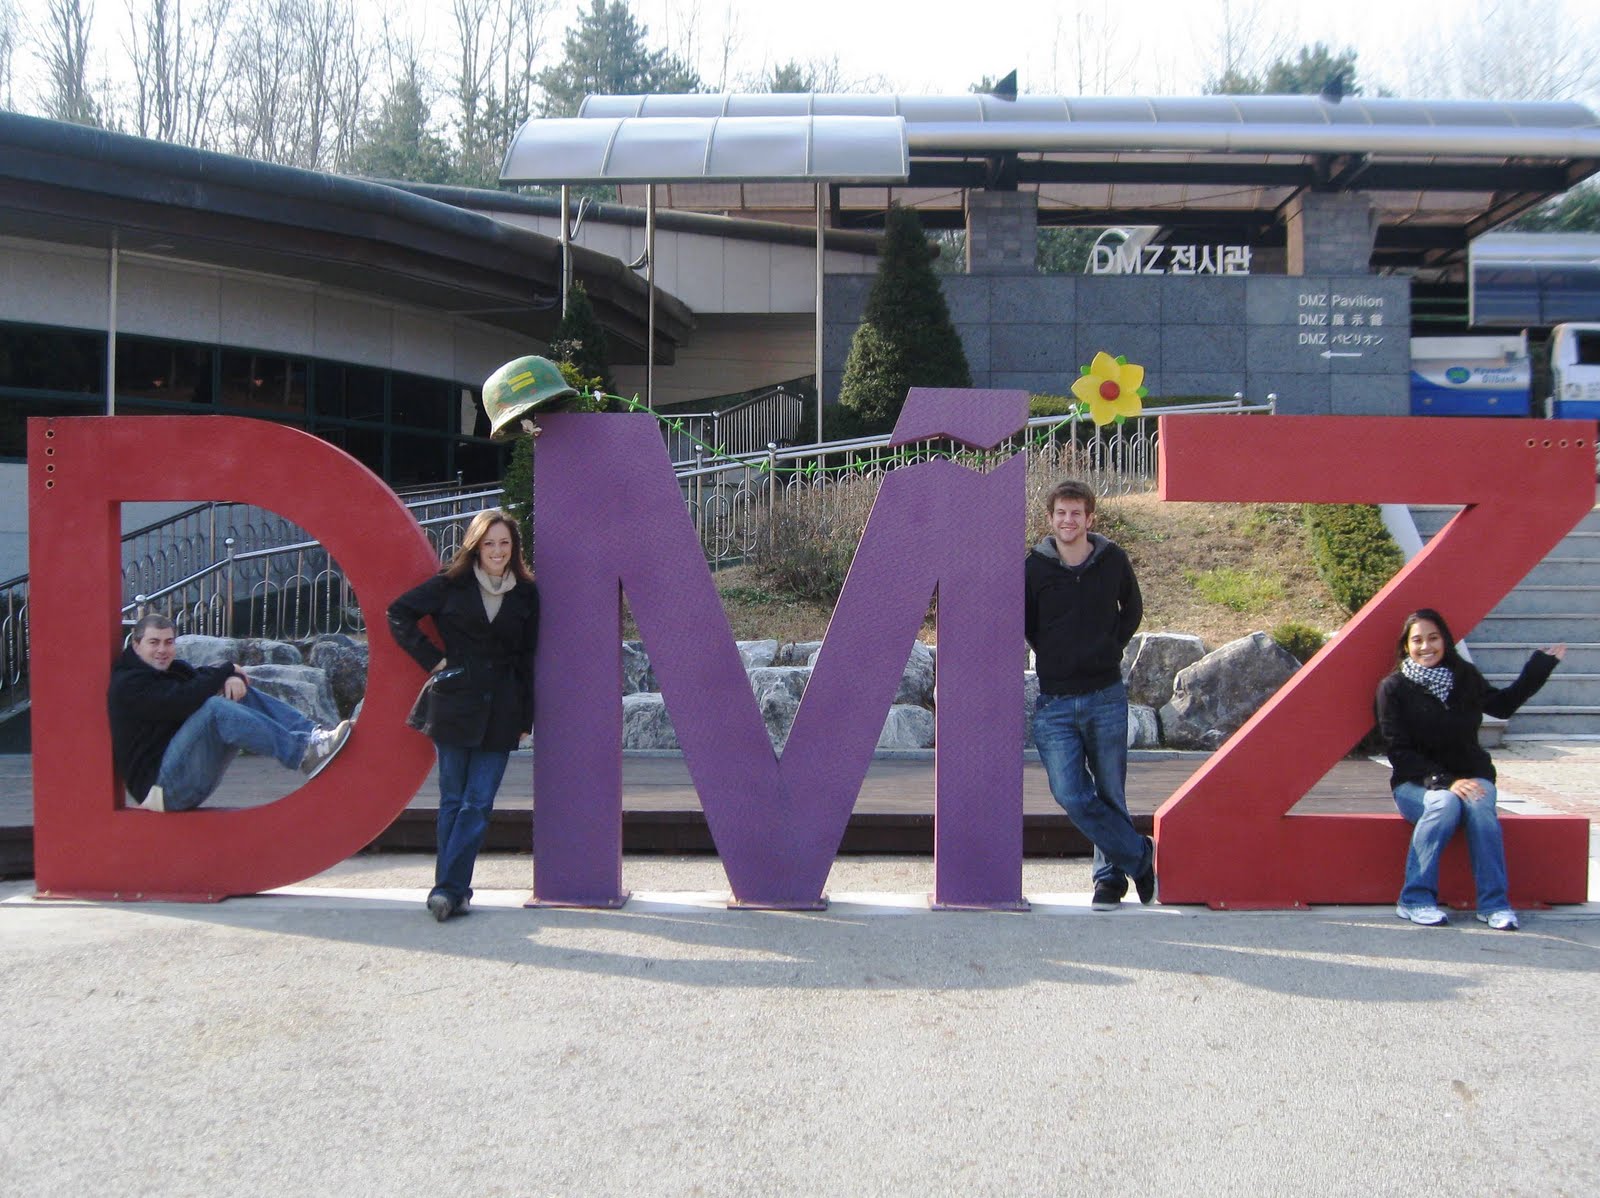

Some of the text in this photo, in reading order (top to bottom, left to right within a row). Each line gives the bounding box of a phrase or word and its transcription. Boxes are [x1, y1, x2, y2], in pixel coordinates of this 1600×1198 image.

[1092, 244, 1252, 275] DMZ 전시관
[1299, 294, 1384, 307] DMZ Pavilion
[1299, 313, 1327, 326] DMZ
[1299, 332, 1327, 345] DMZ
[27, 387, 1598, 910] DMZ
